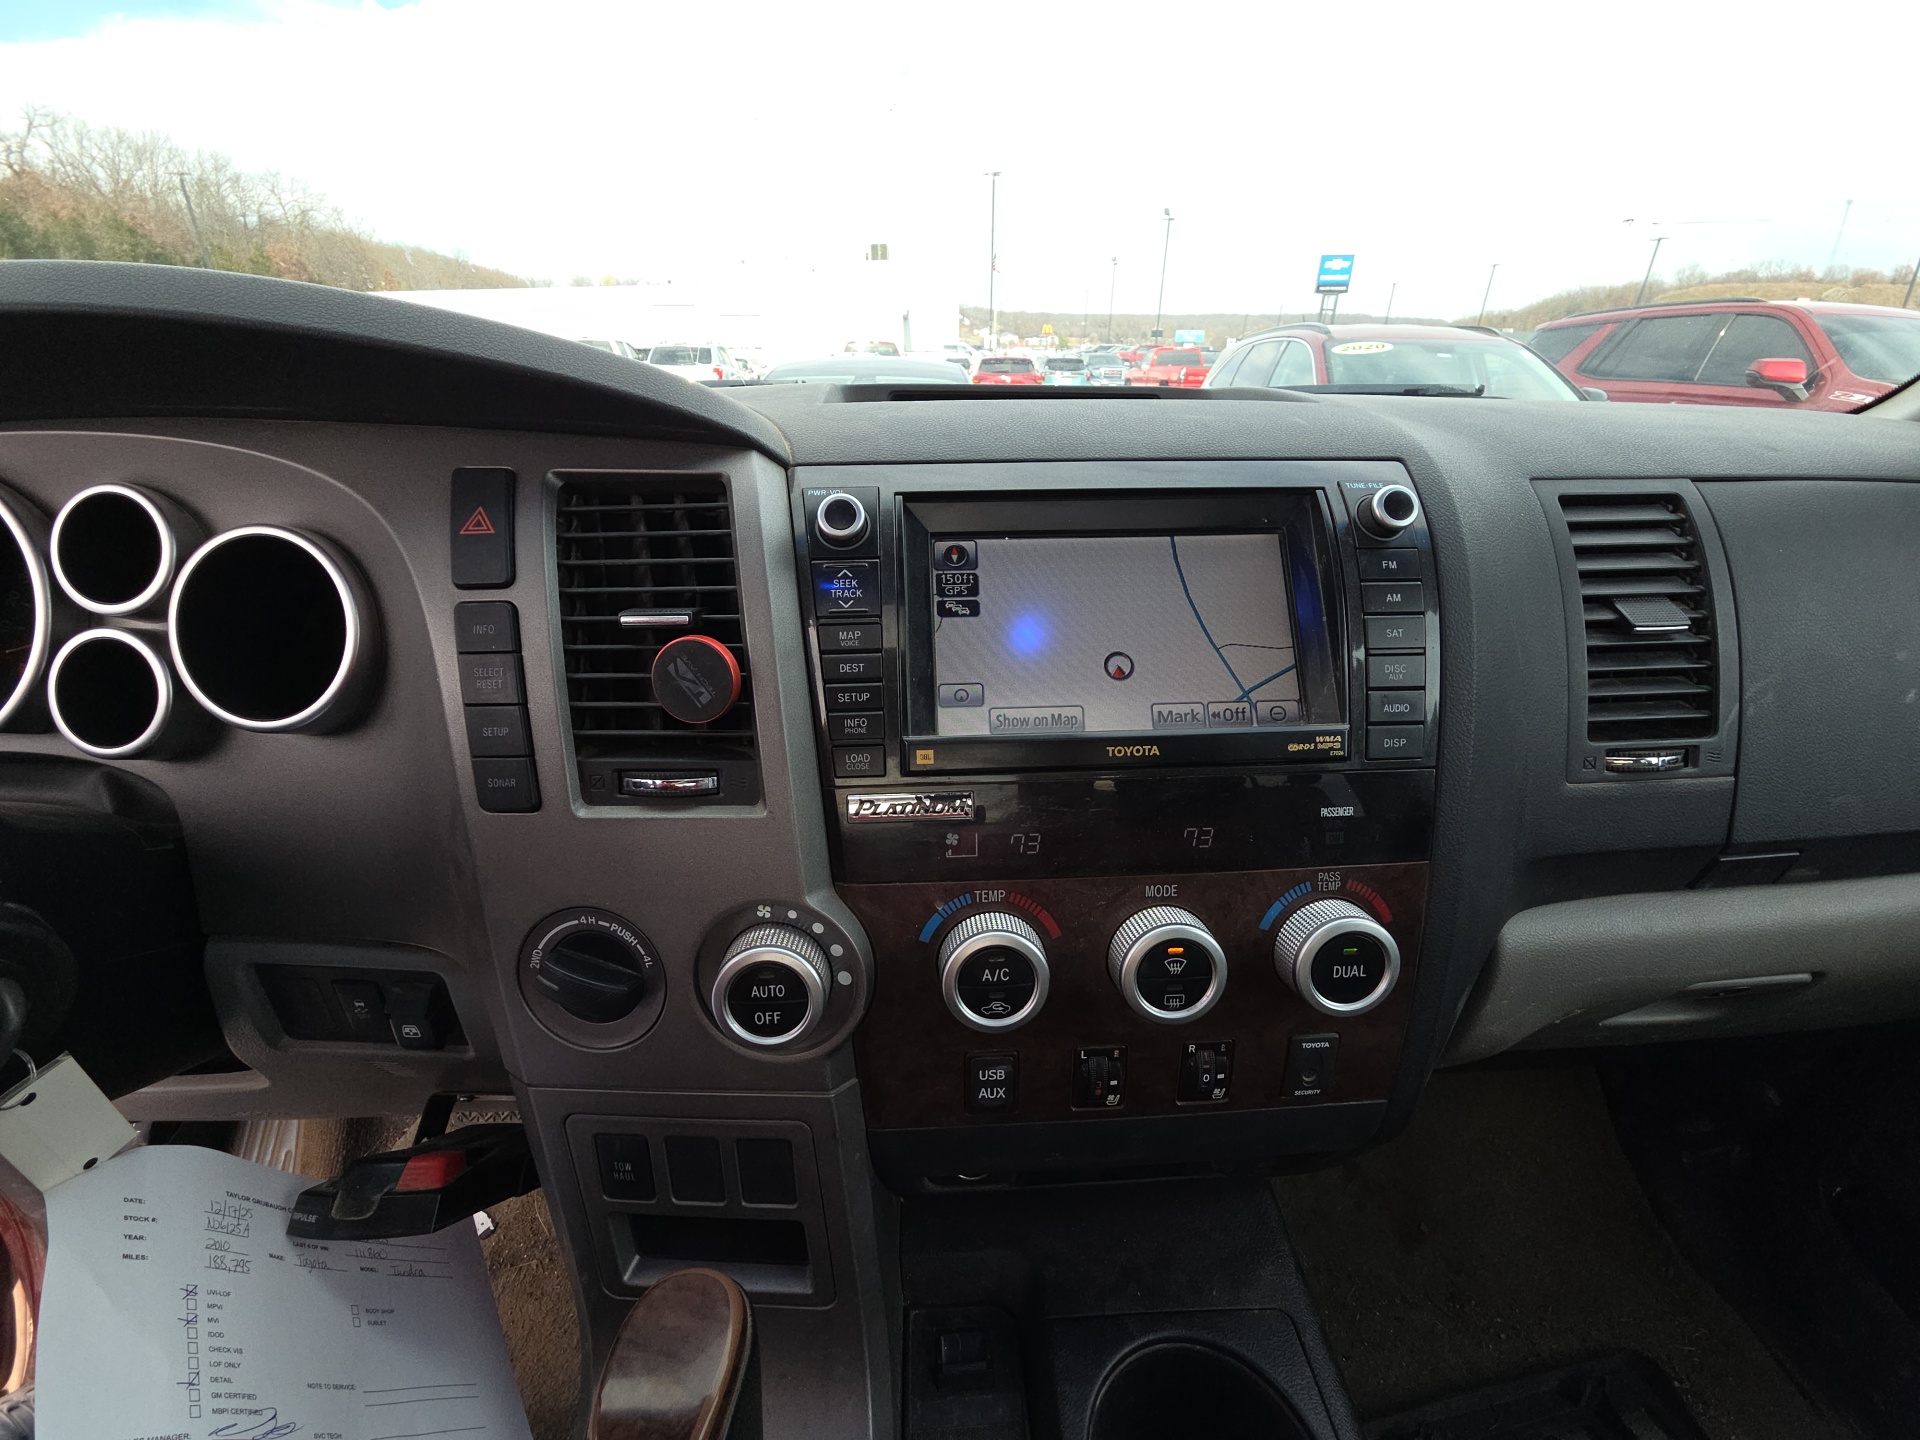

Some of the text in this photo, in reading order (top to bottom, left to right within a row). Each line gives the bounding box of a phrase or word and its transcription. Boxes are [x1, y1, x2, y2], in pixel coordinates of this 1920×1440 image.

[1341, 343, 1385, 352] 2020
[1382, 560, 1397, 569] FM
[832, 579, 858, 588] SEEK
[940, 574, 974, 585] 150ft
[830, 589, 863, 598] TRACK
[944, 585, 968, 595] GPS
[1386, 593, 1401, 602] AM
[473, 624, 495, 635] INFO
[1386, 628, 1404, 638] SAT
[839, 631, 861, 640] MAP
[473, 667, 504, 677] SELECT
[839, 663, 865, 673] DEST
[1384, 664, 1407, 673] DISC
[476, 680, 503, 689] RESET
[837, 692, 870, 702] SETUP
[1383, 703, 1410, 713] AUDIO
[995, 713, 1078, 730] Show on Map
[1156, 708, 1201, 725] Mark
[844, 717, 868, 728] INFO
[482, 727, 509, 737] SETUP
[1383, 737, 1407, 747] DISP
[1106, 745, 1160, 757] TOYOTA
[845, 753, 871, 763] LOAD
[846, 762, 870, 770] CLOSE
[487, 778, 516, 788] SONAR
[1320, 806, 1354, 818] PASSENGER
[1184, 827, 1214, 848] 73
[1010, 833, 1041, 854] 73
[1318, 872, 1341, 882] PASS
[1145, 884, 1178, 897] MODE
[1317, 881, 1342, 891] TEMP
[974, 889, 1006, 903] TEMP
[530, 948, 543, 969] 2WD
[579, 915, 596, 925] 4H
[610, 923, 638, 947] PUSH
[982, 968, 1010, 982] A/C
[1332, 965, 1367, 978] DUAL
[751, 985, 785, 998] AUTO
[754, 1012, 781, 1025] OFF
[1188, 1044, 1196, 1053] R
[1081, 1050, 1088, 1059] L
[978, 1069, 1006, 1081] USB
[978, 1087, 1006, 1099] AUX
[613, 1162, 632, 1171] TOW
[613, 1171, 636, 1181] HAUL
[225, 1191, 251, 1202] TAYLOR
[205, 1237, 231, 1251] 2010
[122, 1253, 149, 1261] MILES:
[296, 1253, 330, 1273] Toyota
[390, 1264, 424, 1277] Tundra
[206, 1289, 232, 1297] UVI-LOF
[208, 1346, 232, 1354] CHECK
[224, 1361, 241, 1369] ONLY
[210, 1376, 234, 1384] DETAIL
[231, 1408, 263, 1416] CERTIFIED
